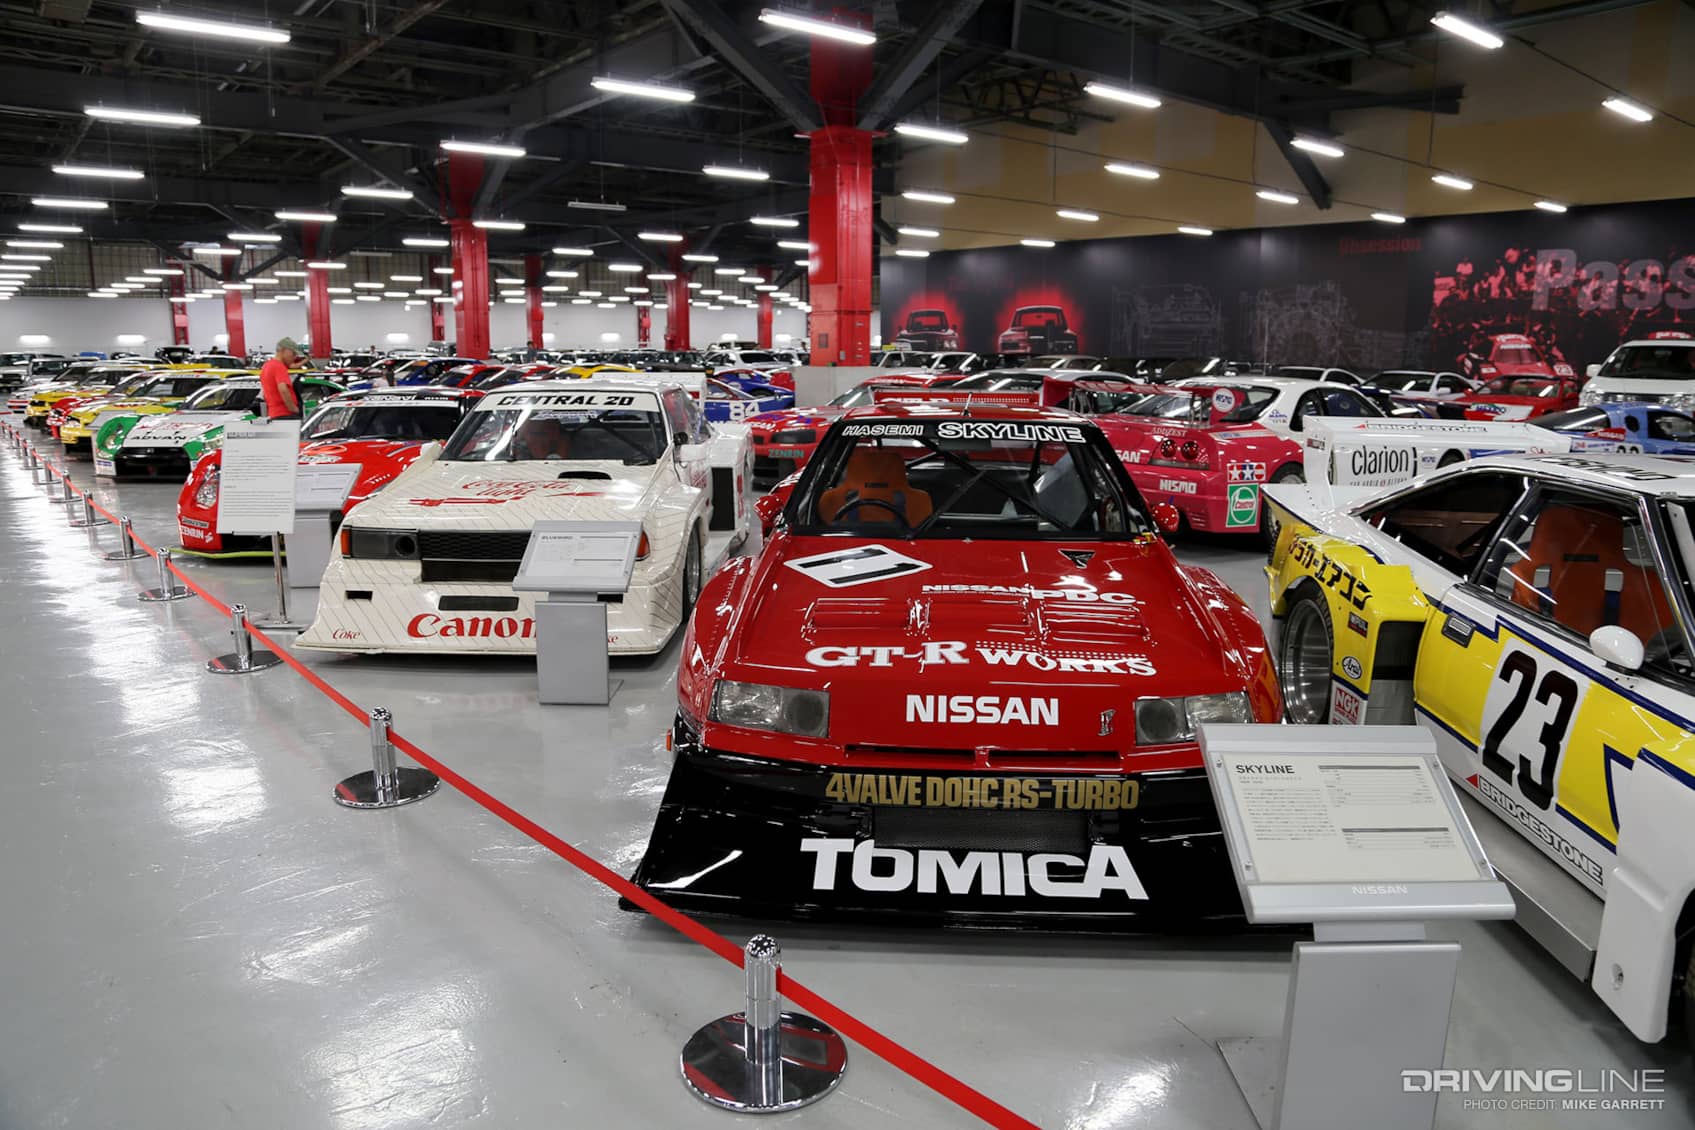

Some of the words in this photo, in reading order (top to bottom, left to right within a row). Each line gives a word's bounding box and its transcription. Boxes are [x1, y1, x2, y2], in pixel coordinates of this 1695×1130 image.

[497, 395, 597, 406] CENTRAL
[604, 396, 635, 406] 20
[729, 401, 761, 421] 84
[842, 425, 924, 436] HASEMI
[937, 422, 1087, 443] SKYLINE
[1351, 445, 1409, 476] clarion
[1159, 479, 1198, 494] NISMO
[333, 629, 360, 640] Coke
[975, 649, 1157, 676] WORKS
[905, 695, 1059, 726] NISSAN
[1336, 688, 1360, 717] NGK
[1482, 650, 1578, 811] 23
[1235, 764, 1295, 774] SKYLINE
[926, 777, 999, 808] DOHC
[1003, 780, 1140, 810] RS-TURBO
[1478, 776, 1605, 886] BRIDGESTONE
[800, 838, 1150, 900] TOMICA
[1351, 886, 1409, 896] NISSAN
